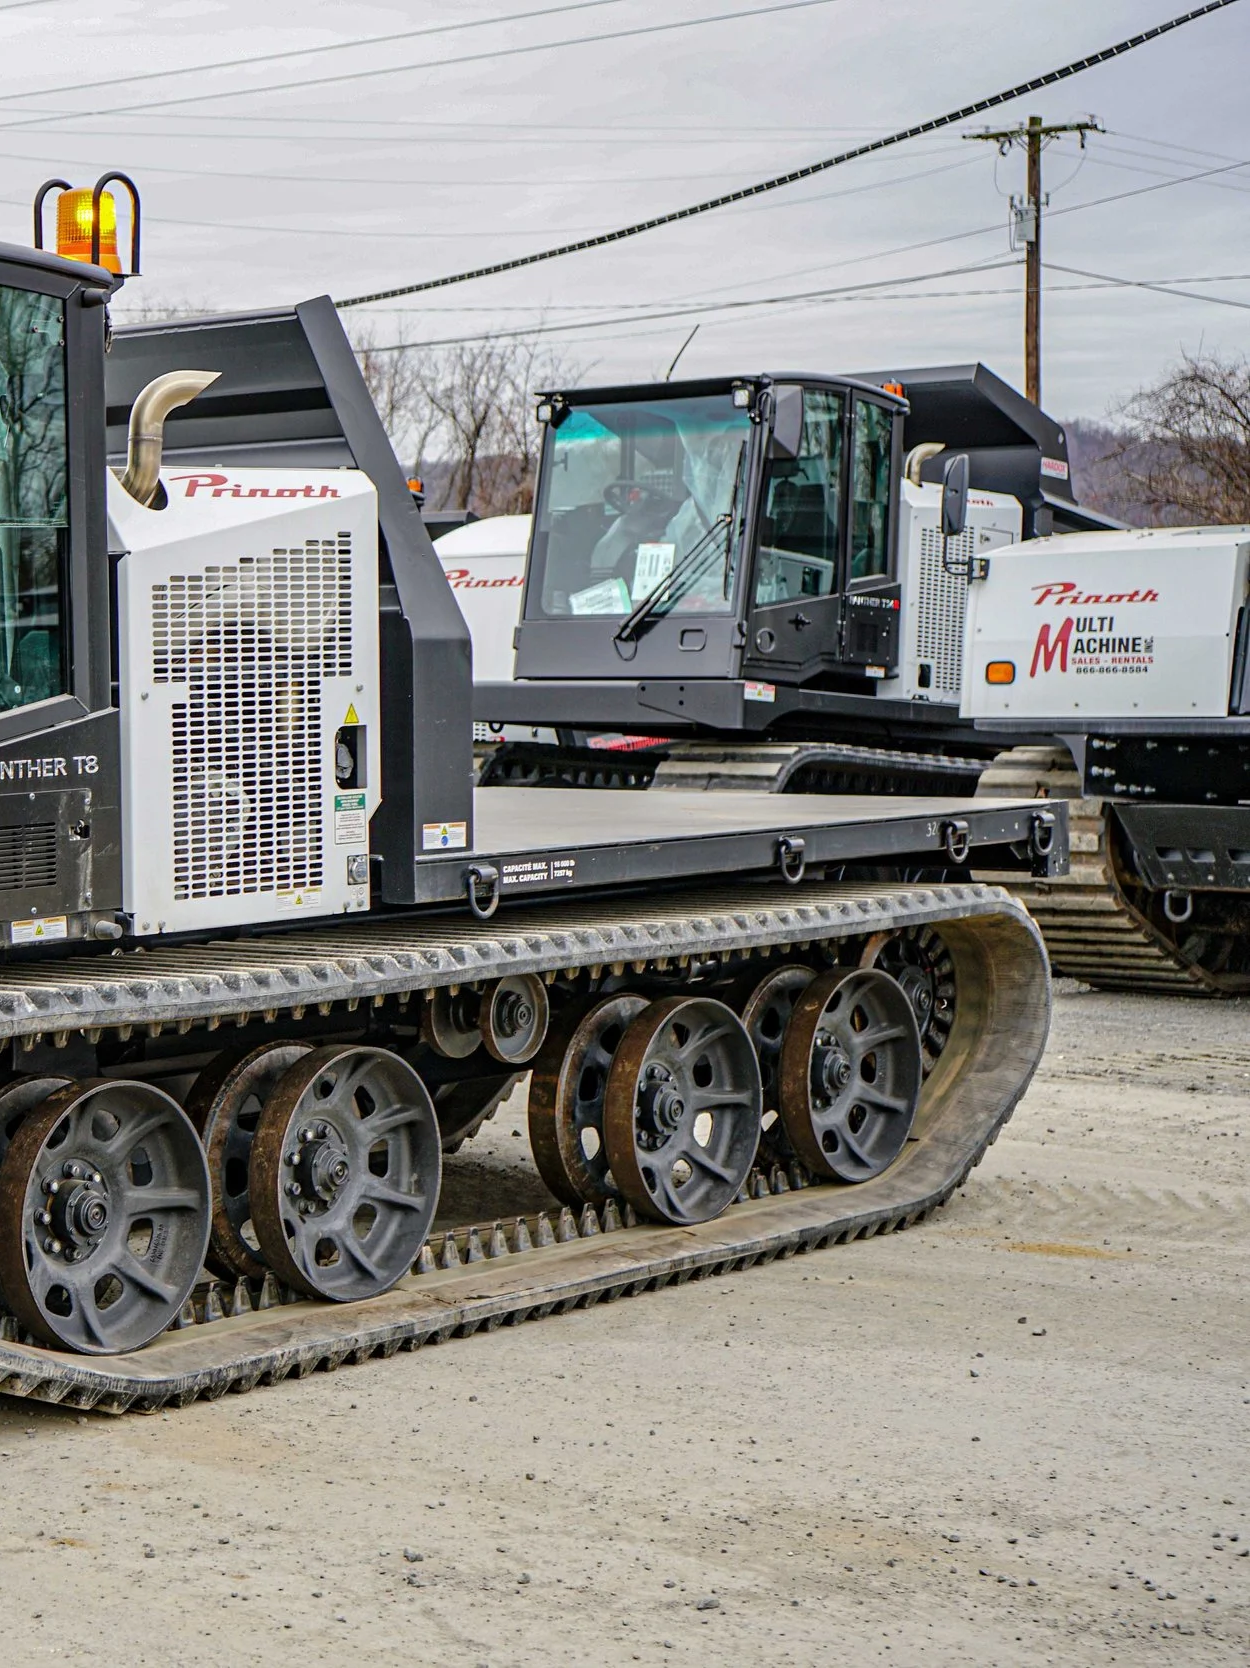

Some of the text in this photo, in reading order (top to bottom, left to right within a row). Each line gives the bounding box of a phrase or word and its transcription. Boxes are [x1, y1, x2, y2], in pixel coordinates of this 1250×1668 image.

[169, 473, 341, 498] Prinoth
[1031, 582, 1159, 606] Prinoth
[1071, 656, 1101, 665] SALES
[1111, 656, 1154, 664] RENTALS
[1076, 665, 1148, 675] 866-866-8584
[72, 755, 100, 775] T8
[503, 861, 532, 874] CAPACITÉ
[532, 861, 548, 871] MAX.
[503, 875, 519, 884] MAX.
[519, 872, 548, 883] CAPACITY
